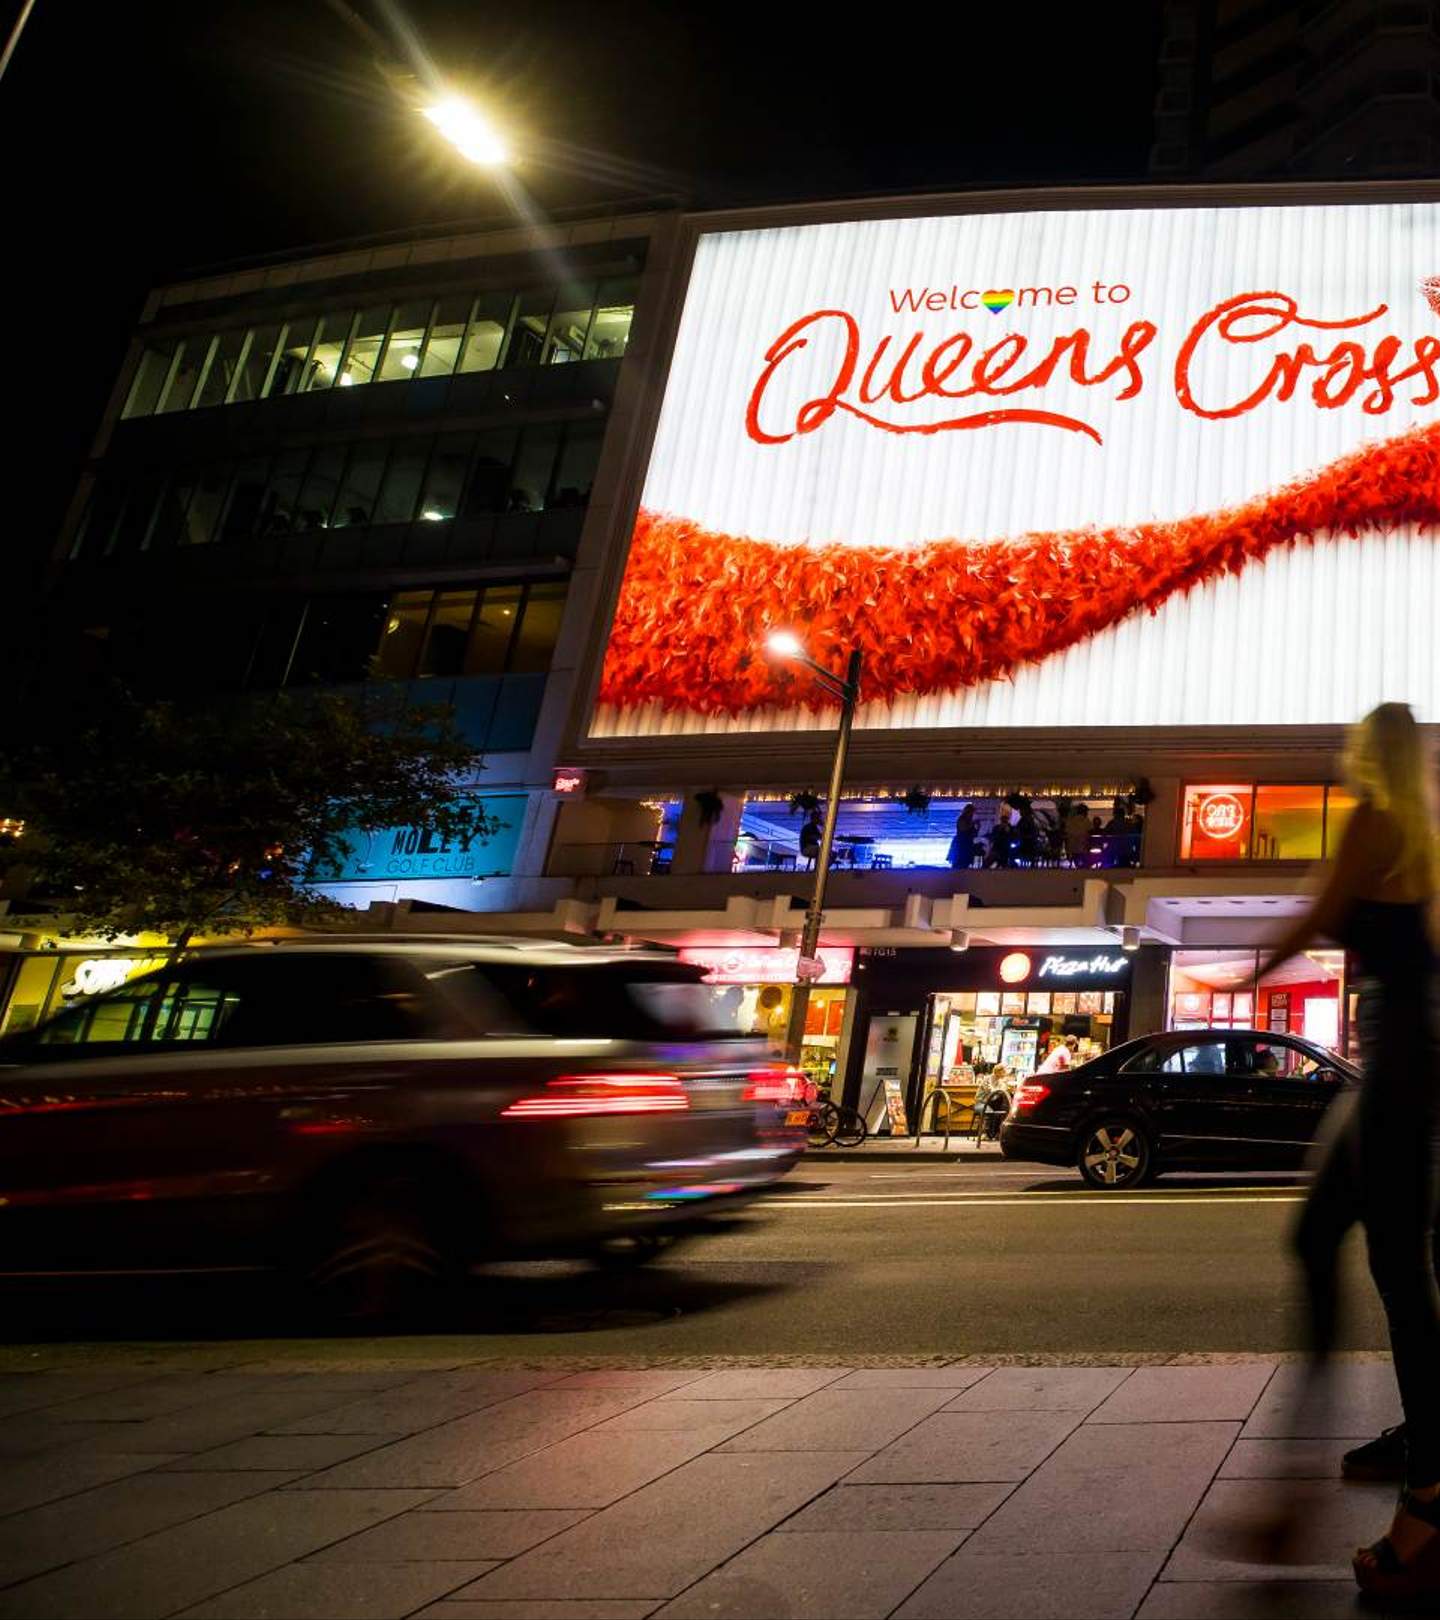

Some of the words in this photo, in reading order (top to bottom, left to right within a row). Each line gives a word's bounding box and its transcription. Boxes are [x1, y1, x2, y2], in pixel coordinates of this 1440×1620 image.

[1091, 280, 1132, 306] to
[745, 308, 1158, 446] Queens
[386, 857, 430, 875] GOLF
[431, 854, 475, 873] CLUB
[1038, 954, 1089, 978] Pizza
[1089, 954, 1129, 974] Hut
